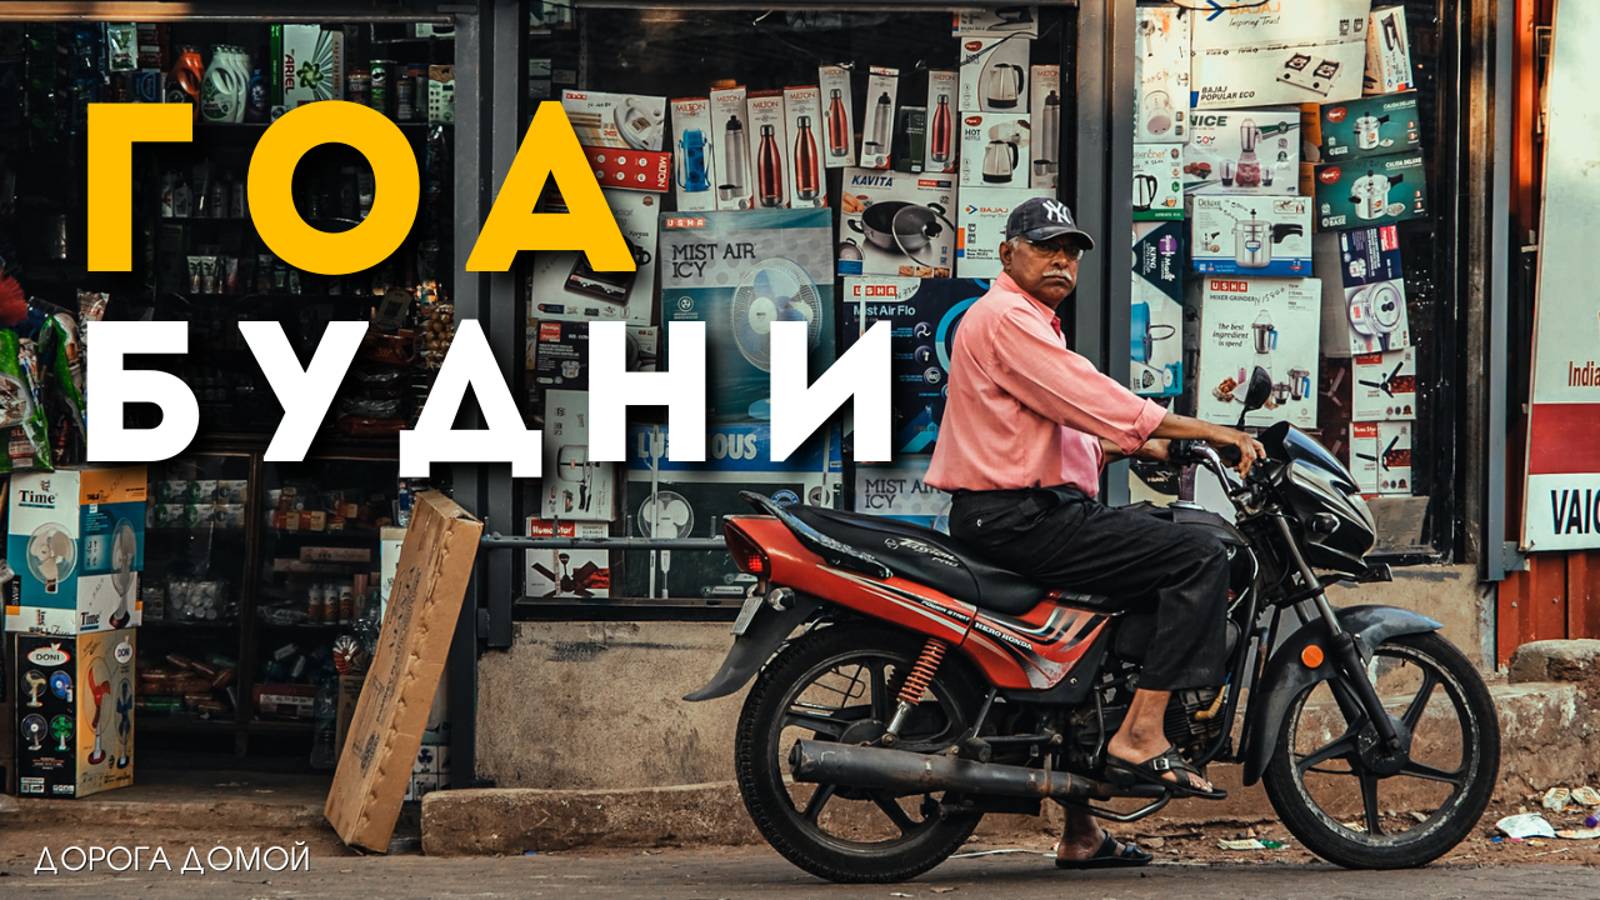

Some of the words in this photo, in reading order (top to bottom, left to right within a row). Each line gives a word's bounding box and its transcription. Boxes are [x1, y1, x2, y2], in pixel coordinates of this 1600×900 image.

[285, 54, 295, 95] ARIEL
[1200, 92, 1237, 101] POPULAR
[1239, 91, 1256, 99] ECO
[851, 176, 893, 187] KAVITA
[667, 218, 704, 229] USHA
[672, 244, 718, 260] MIST
[722, 243, 756, 260] AIR
[672, 261, 707, 278] ICY
[1211, 281, 1248, 292] USHA
[879, 306, 896, 316] Air
[897, 306, 916, 316] Flo
[1213, 330, 1249, 339] ingredient
[865, 479, 907, 494] MIST
[18, 490, 56, 504] Time
[865, 494, 896, 509] ICY
[974, 622, 1002, 637] HERO
[1001, 633, 1033, 651] HONDA
[36, 653, 60, 661] DONI
